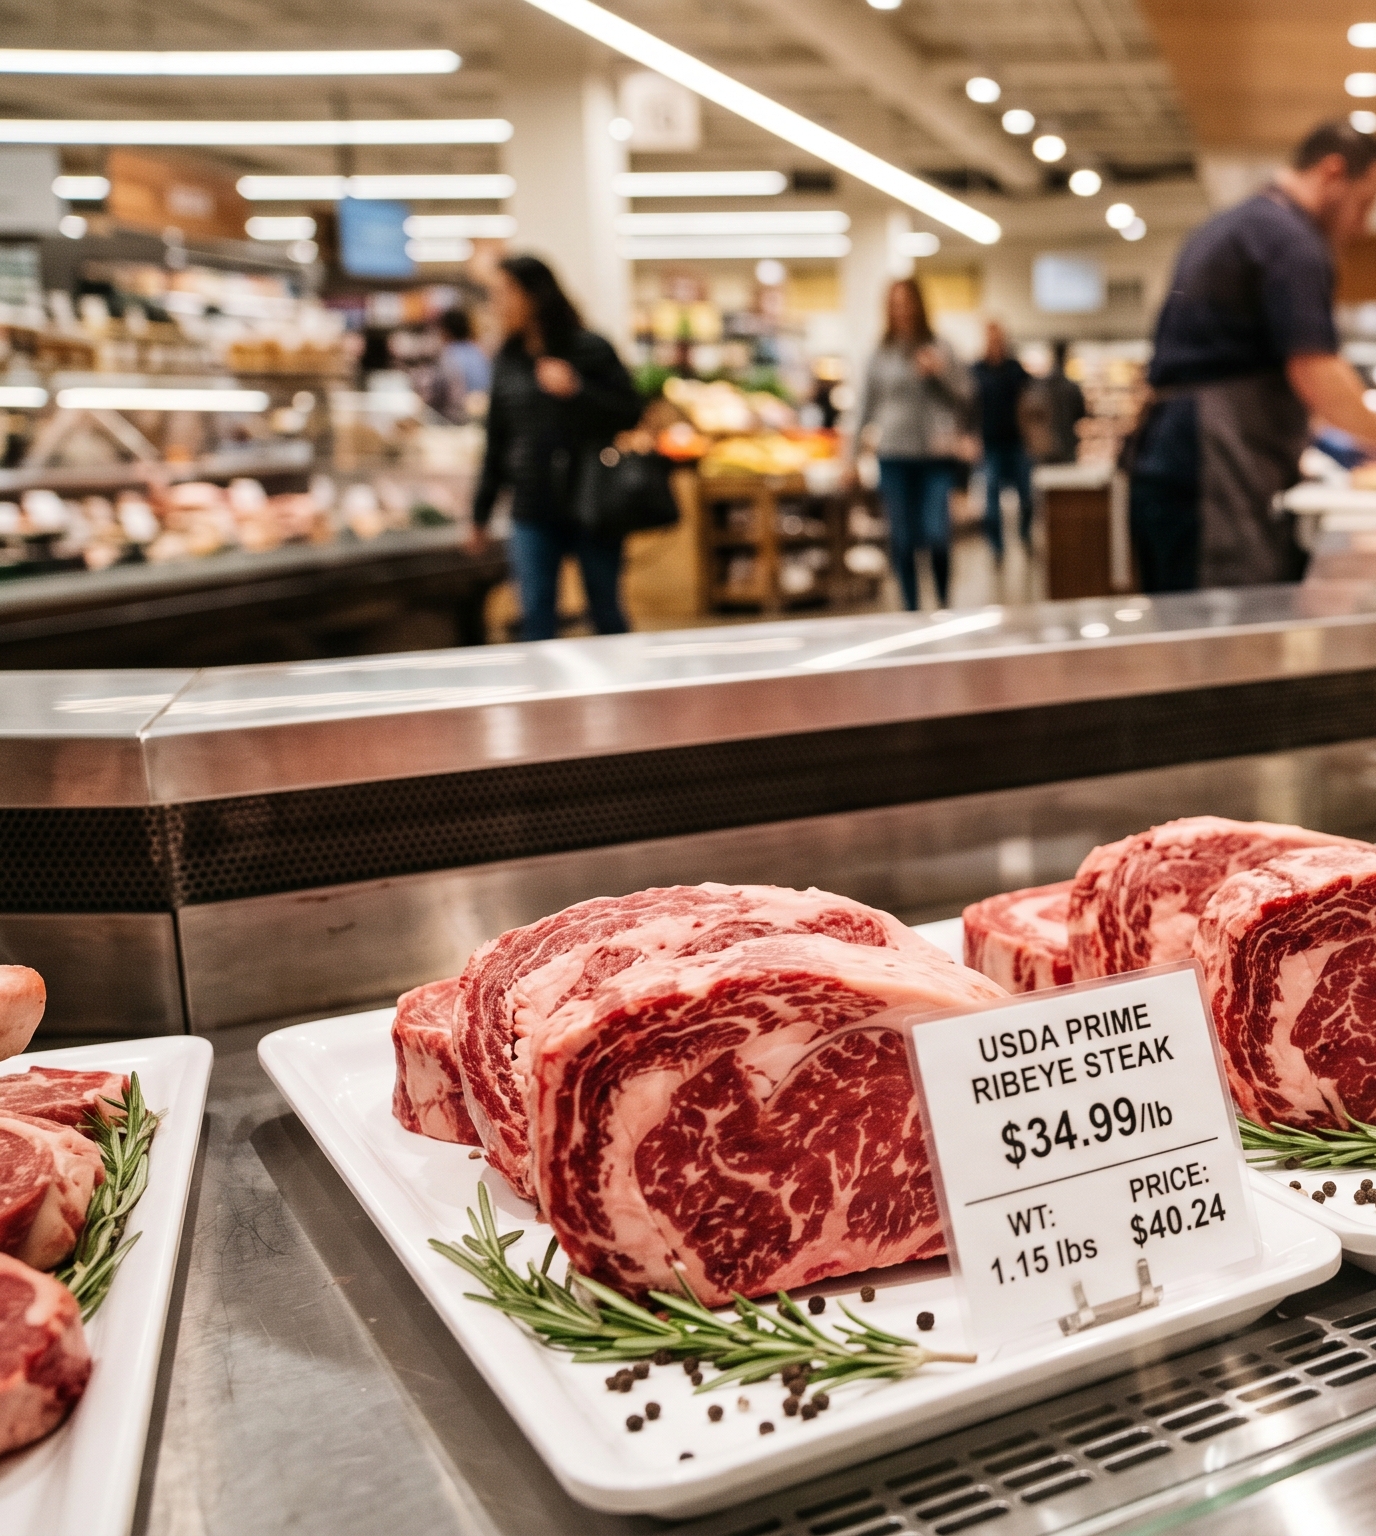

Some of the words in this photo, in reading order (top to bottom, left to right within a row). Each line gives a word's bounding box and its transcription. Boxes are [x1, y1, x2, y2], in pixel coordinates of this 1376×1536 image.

[979, 1024, 1060, 1062] USDA
[1066, 1003, 1152, 1045] PRIME
[972, 1058, 1077, 1104] RIBEYE
[1084, 1035, 1174, 1078] STEAK
[1001, 1097, 1173, 1169] $34.99/lb
[1129, 1162, 1210, 1203] PRICE:
[1007, 1204, 1056, 1237] WT:
[1131, 1193, 1226, 1248] $40.24
[991, 1245, 1049, 1285] 1.15
[1057, 1237, 1098, 1268] lbs
